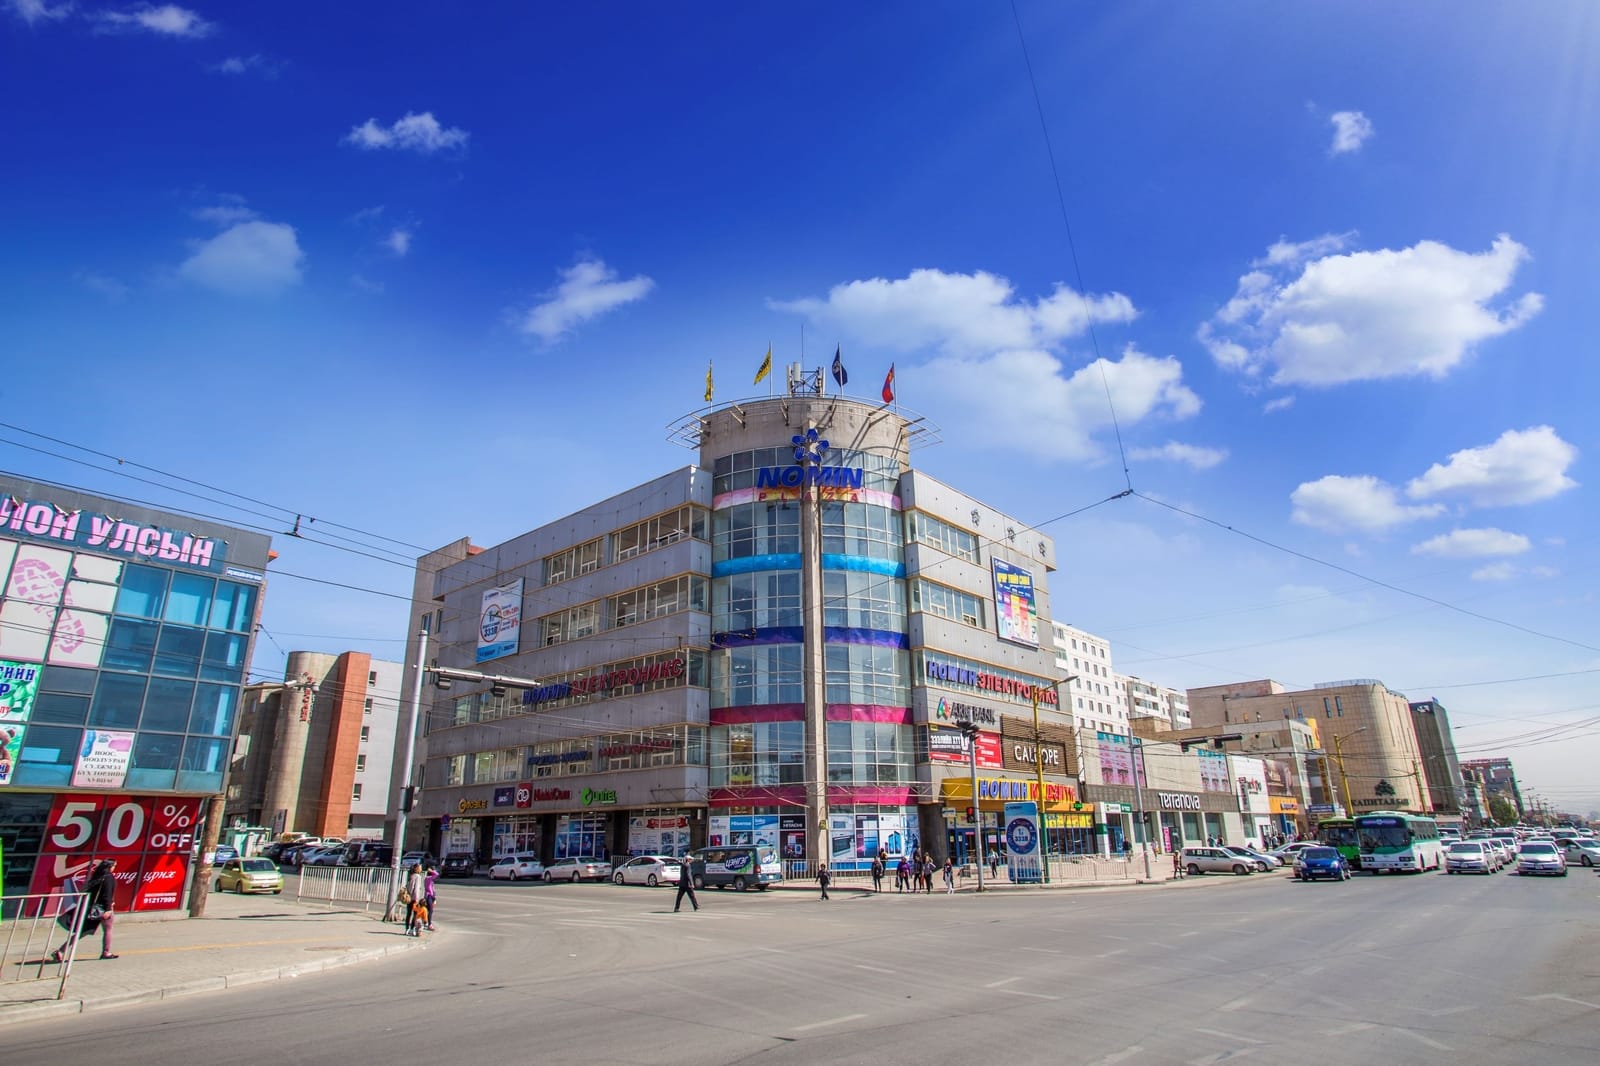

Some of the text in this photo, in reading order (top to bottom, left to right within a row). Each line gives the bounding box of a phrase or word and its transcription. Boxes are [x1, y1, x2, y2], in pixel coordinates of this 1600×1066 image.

[757, 466, 863, 489] NOMIN
[87, 516, 214, 567] УЛСЫН
[570, 658, 685, 697] ЭЛЕКТРОНИКС
[927, 661, 976, 687] НОМИН
[979, 780, 1028, 799] НОМИН
[52, 801, 190, 849] 50 %
[150, 833, 192, 848] OFF
